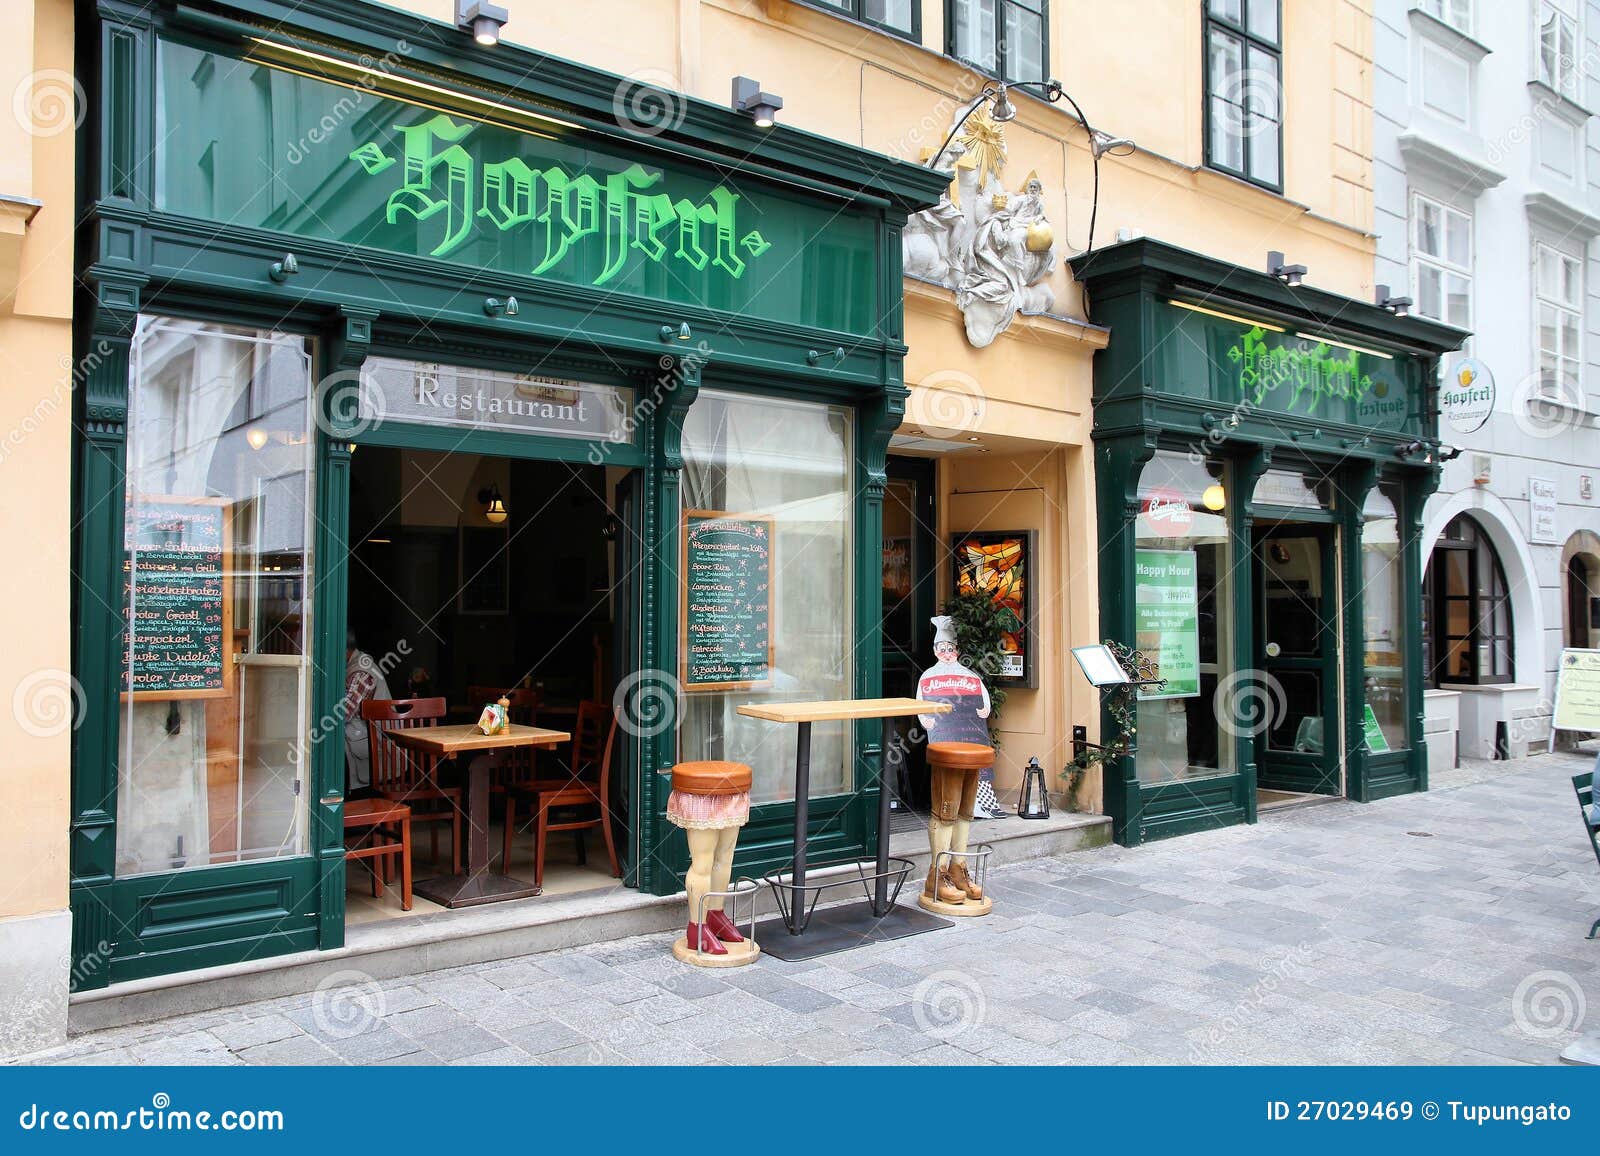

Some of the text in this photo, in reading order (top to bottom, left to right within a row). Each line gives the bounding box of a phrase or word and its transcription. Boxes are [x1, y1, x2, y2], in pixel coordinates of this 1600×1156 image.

[387, 114, 745, 285] Hopferl
[415, 375, 589, 422] Restaurant
[1443, 386, 1491, 408] Hopferl
[1136, 564, 1191, 577] Happy Hour
